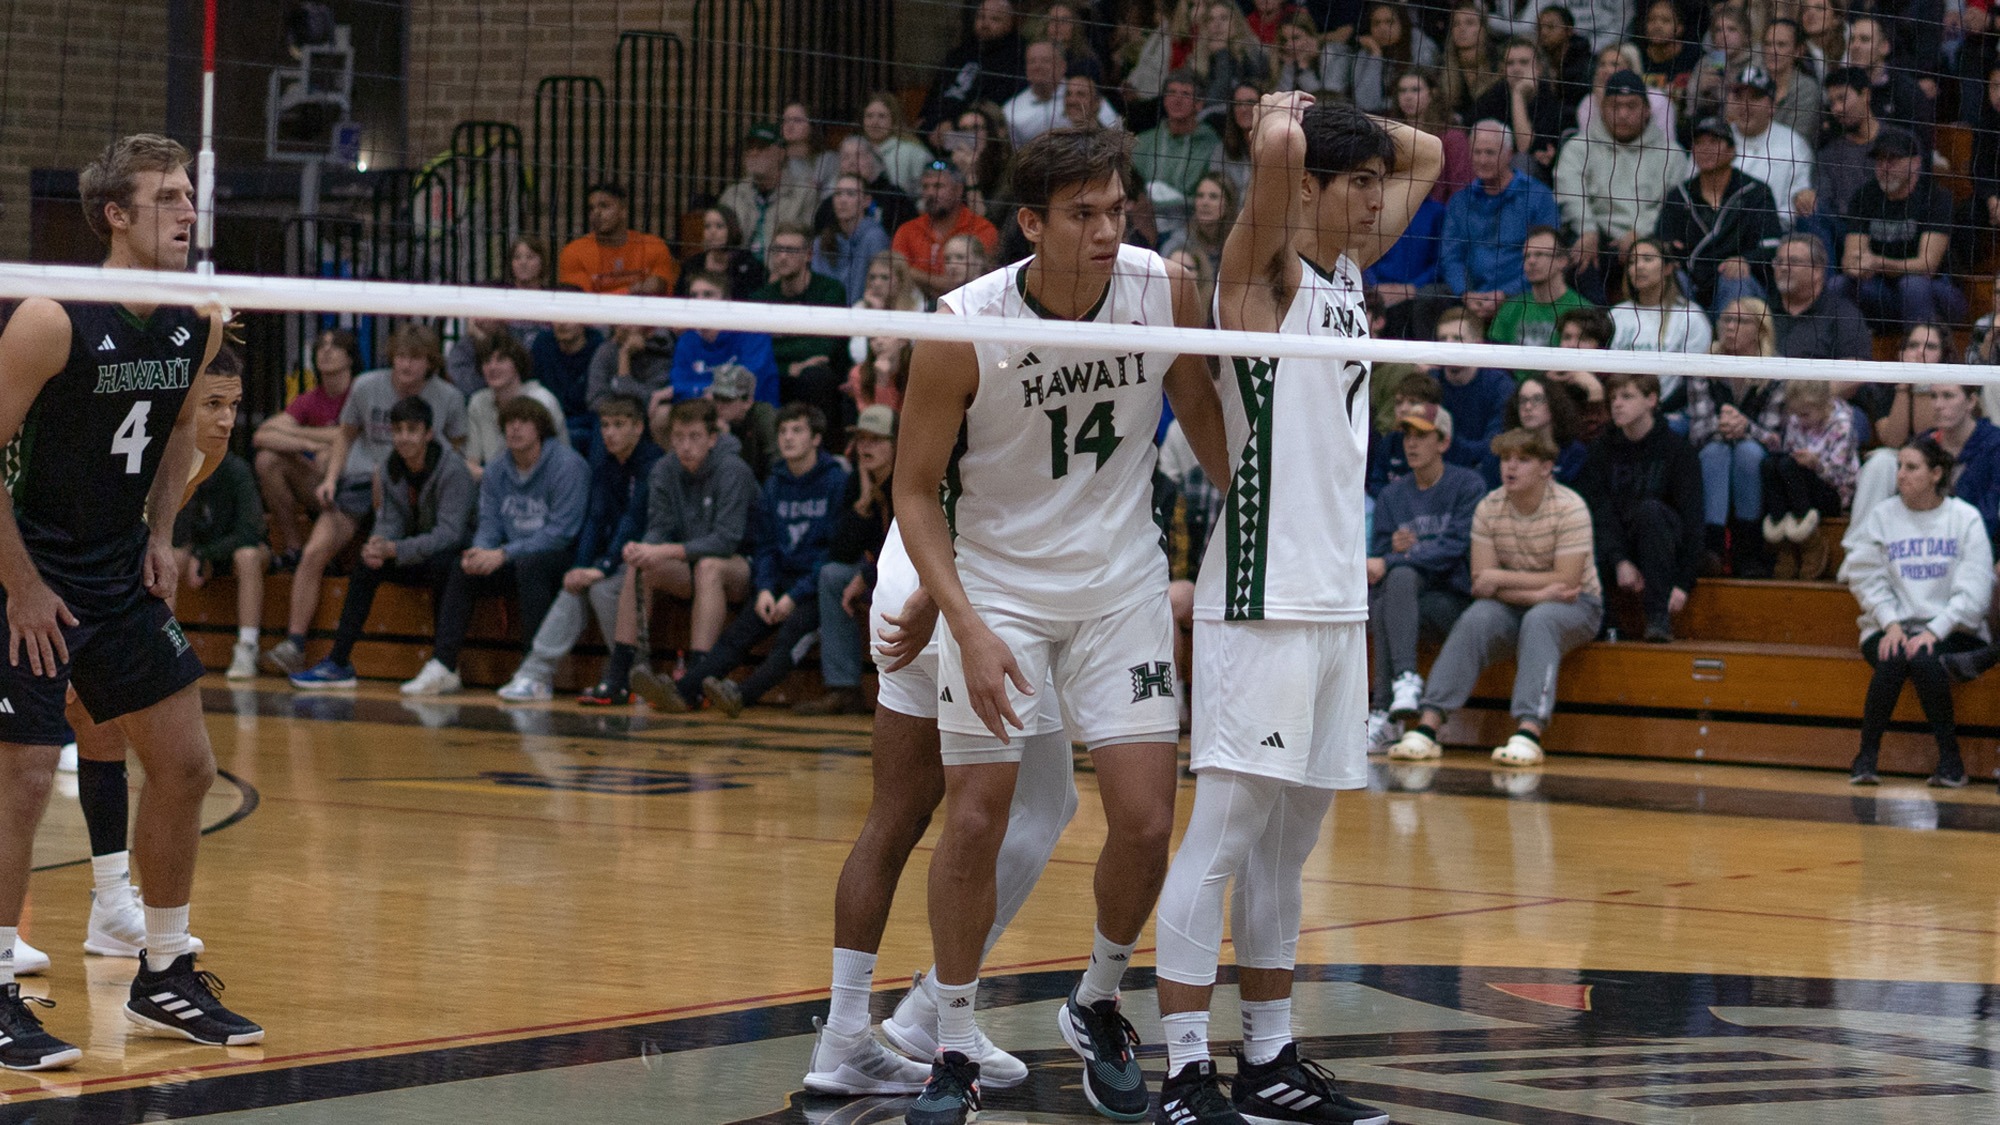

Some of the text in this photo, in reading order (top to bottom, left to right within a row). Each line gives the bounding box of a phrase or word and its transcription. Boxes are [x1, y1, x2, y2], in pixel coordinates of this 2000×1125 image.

[110, 400, 153, 474] 4
[1043, 400, 1125, 480] 14
[1127, 660, 1175, 704] H
